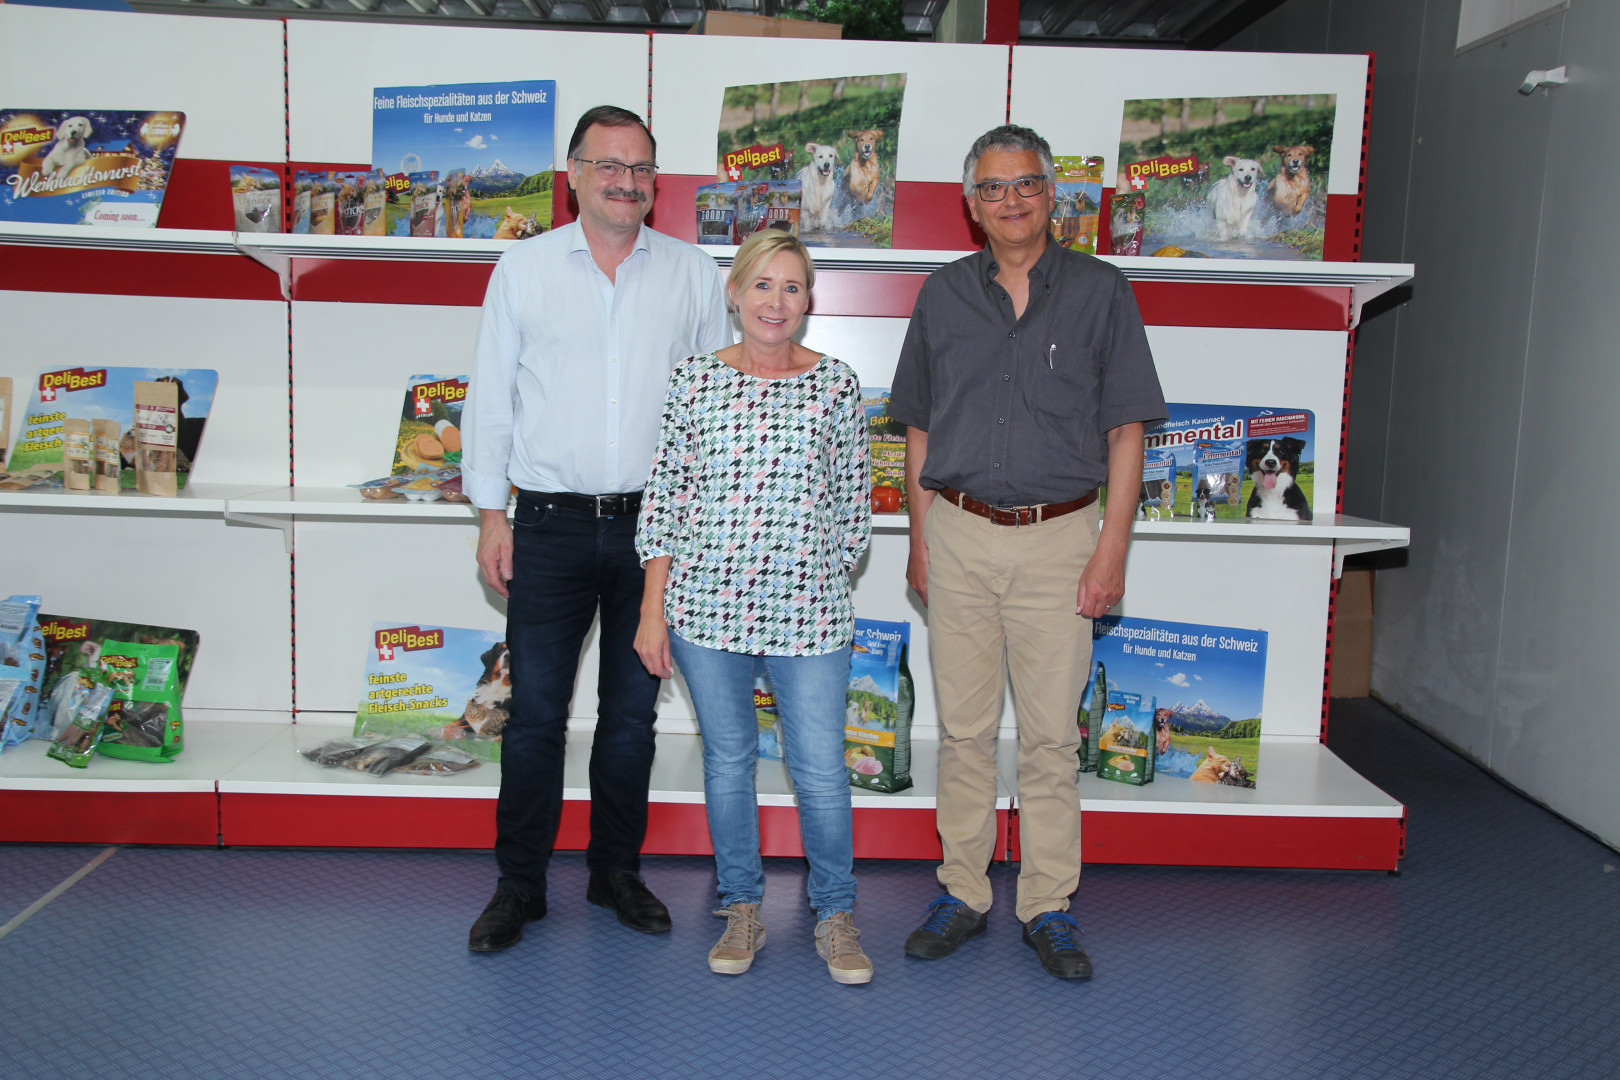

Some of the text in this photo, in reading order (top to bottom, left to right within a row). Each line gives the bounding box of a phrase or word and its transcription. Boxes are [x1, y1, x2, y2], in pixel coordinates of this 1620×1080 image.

[374, 89, 547, 111] Feine Fleischspezialitäten aus der Schweiz
[424, 111, 492, 124] für Hunde und Katzen
[4, 130, 52, 143] DeliBest
[727, 147, 781, 168] DeliBest
[1130, 159, 1194, 177] DeliBest
[6, 160, 141, 200] Weihnachtswurst
[385, 176, 410, 191] eliBe
[94, 209, 119, 223] Coming
[43, 371, 103, 389] DeliBest
[417, 382, 468, 400] DeliBe
[28, 412, 66, 425] feinste
[1192, 416, 1226, 425] Kausnack
[25, 426, 65, 439] artgere
[1144, 420, 1243, 449] mmental
[41, 621, 88, 640] eliBest
[380, 629, 439, 648] DeliBest
[1095, 622, 1259, 653] Fleischspezialitäten aus der Schweiz
[1123, 643, 1197, 662] für Hunde und Katzen
[368, 672, 407, 685] feinste
[368, 682, 433, 701] artgerechte
[754, 694, 776, 705] Best
[368, 696, 448, 714] Fleisch-Snacks
